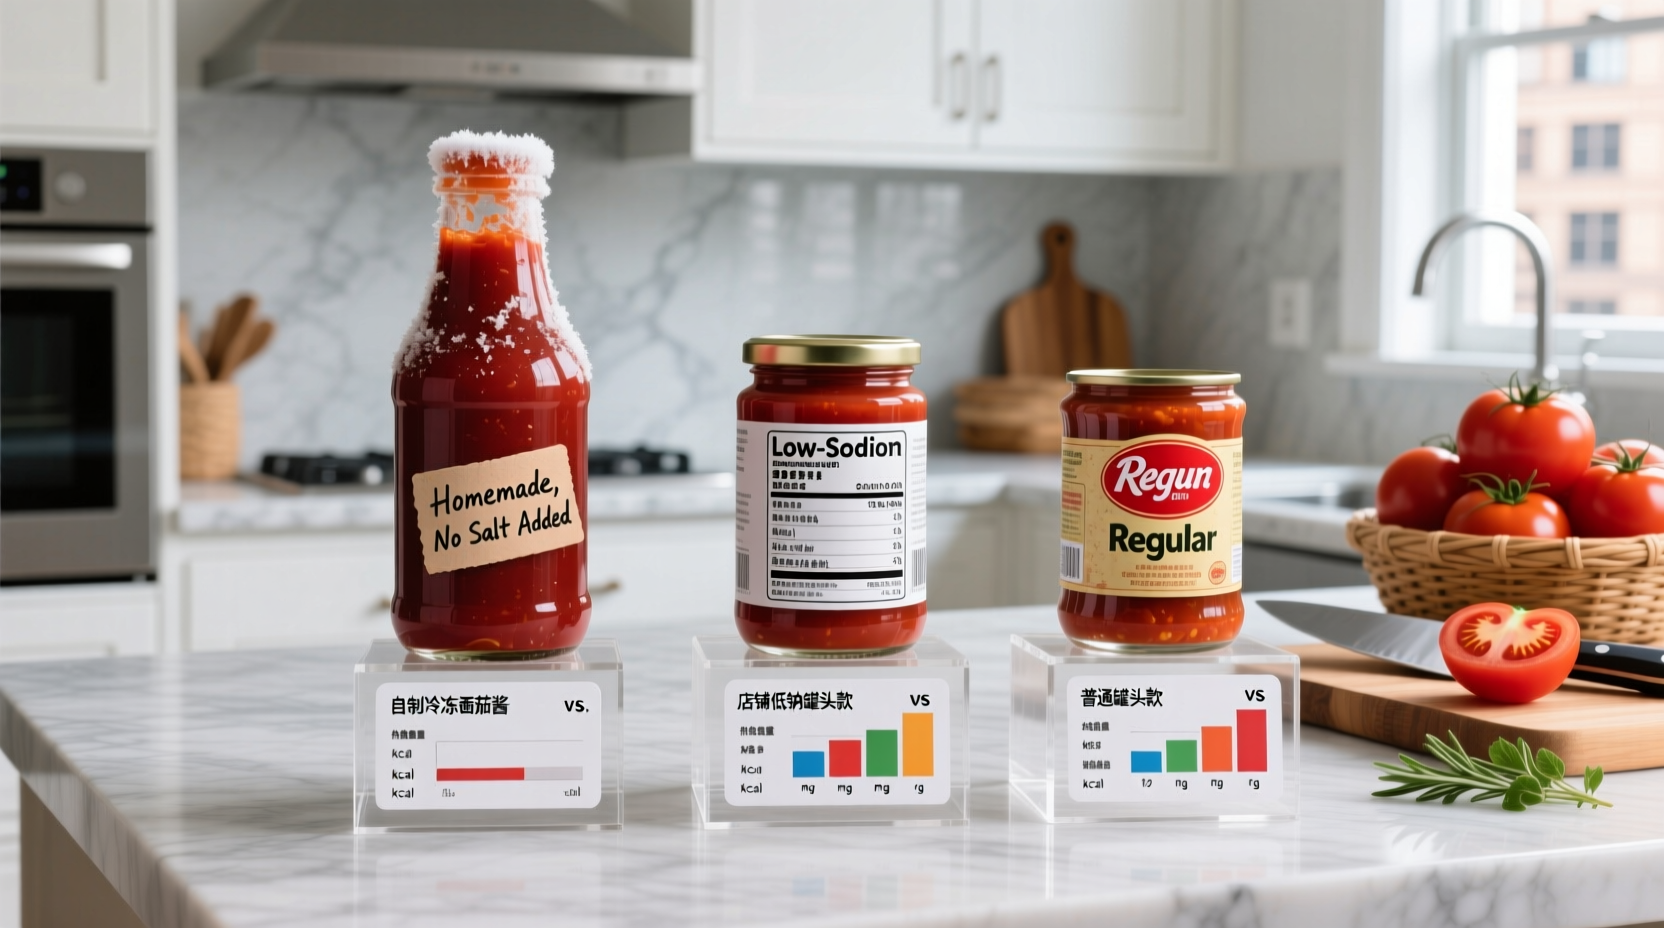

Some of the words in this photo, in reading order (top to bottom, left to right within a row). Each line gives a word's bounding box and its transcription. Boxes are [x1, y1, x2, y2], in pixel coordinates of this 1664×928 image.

[772, 436, 901, 458] Low-Sodion
[430, 468, 559, 518] Homemade,
[1113, 455, 1213, 502] Regun
[434, 524, 462, 552] No
[468, 516, 511, 545] Salt
[517, 498, 572, 537] Added
[1109, 523, 1217, 561] Regular
